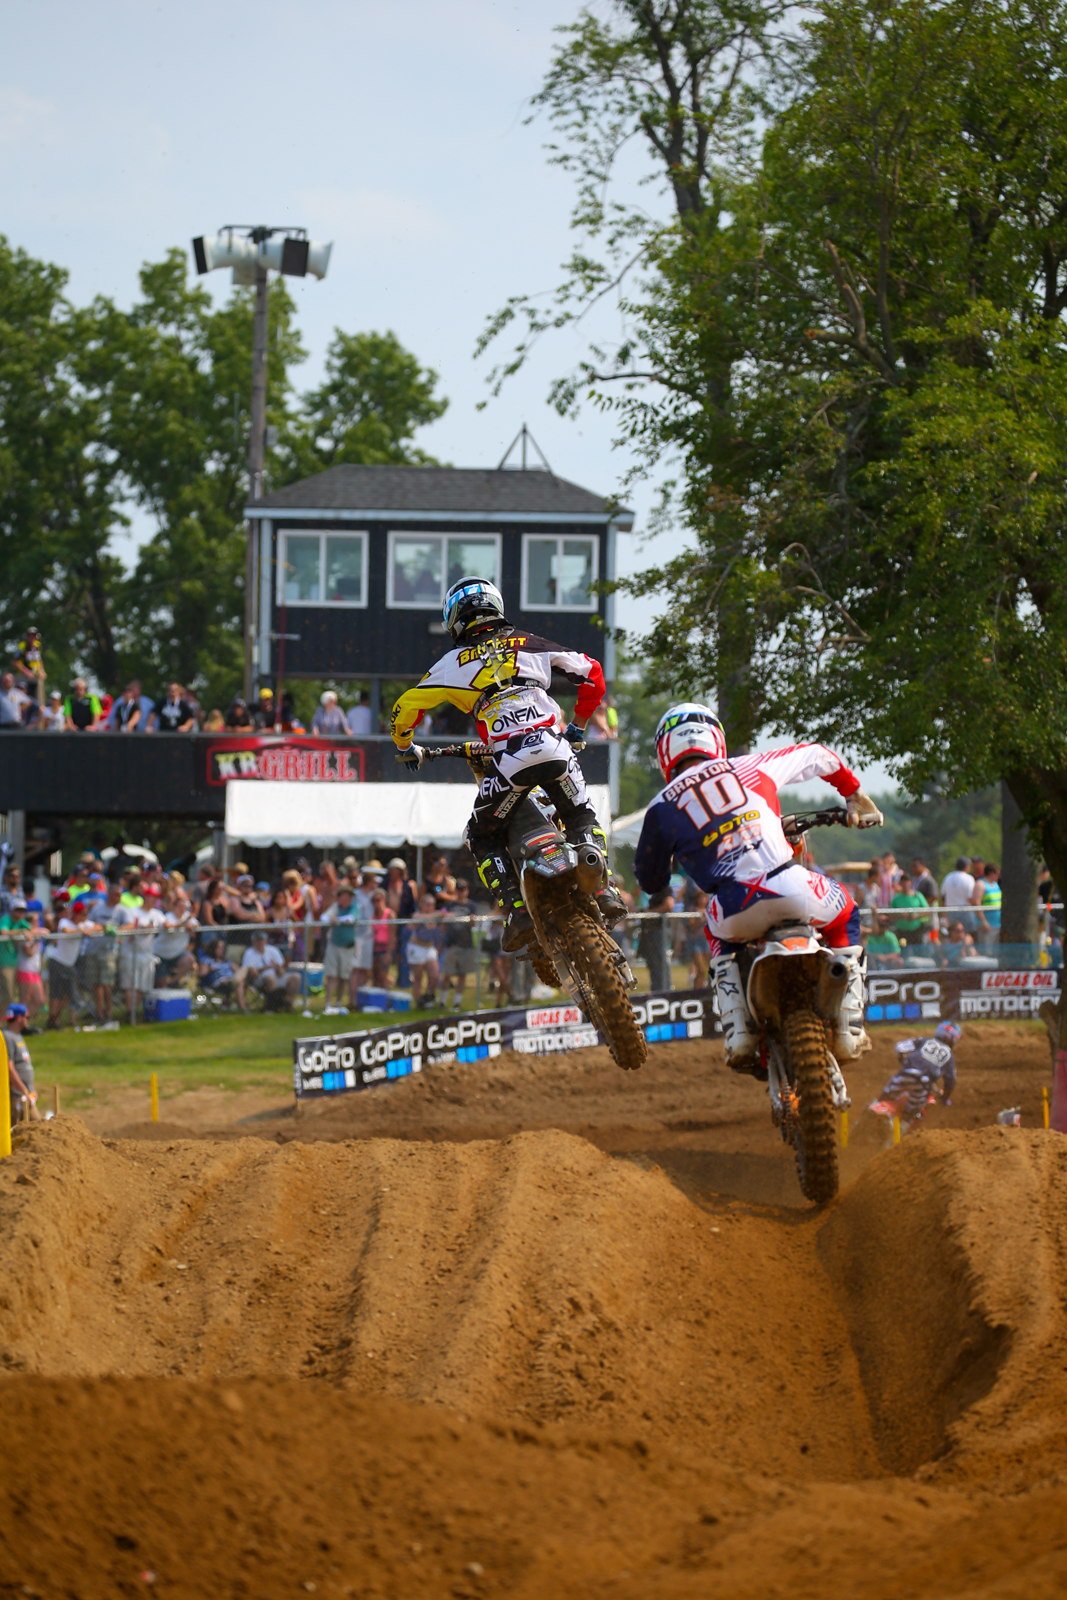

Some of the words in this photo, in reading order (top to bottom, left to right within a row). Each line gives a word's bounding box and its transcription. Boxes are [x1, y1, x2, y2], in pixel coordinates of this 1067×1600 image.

[260, 749, 357, 781] GRILL
[664, 761, 733, 801] BRAYTON
[498, 793, 522, 819] SUZUKI
[677, 772, 747, 831] 10
[986, 973, 1030, 988] LUCAS
[1032, 972, 1053, 987] OIL
[530, 1010, 560, 1027] LUCAS
[563, 1008, 579, 1022] OIL
[360, 1032, 423, 1065] GoPro
[427, 1020, 501, 1049] GoPro
